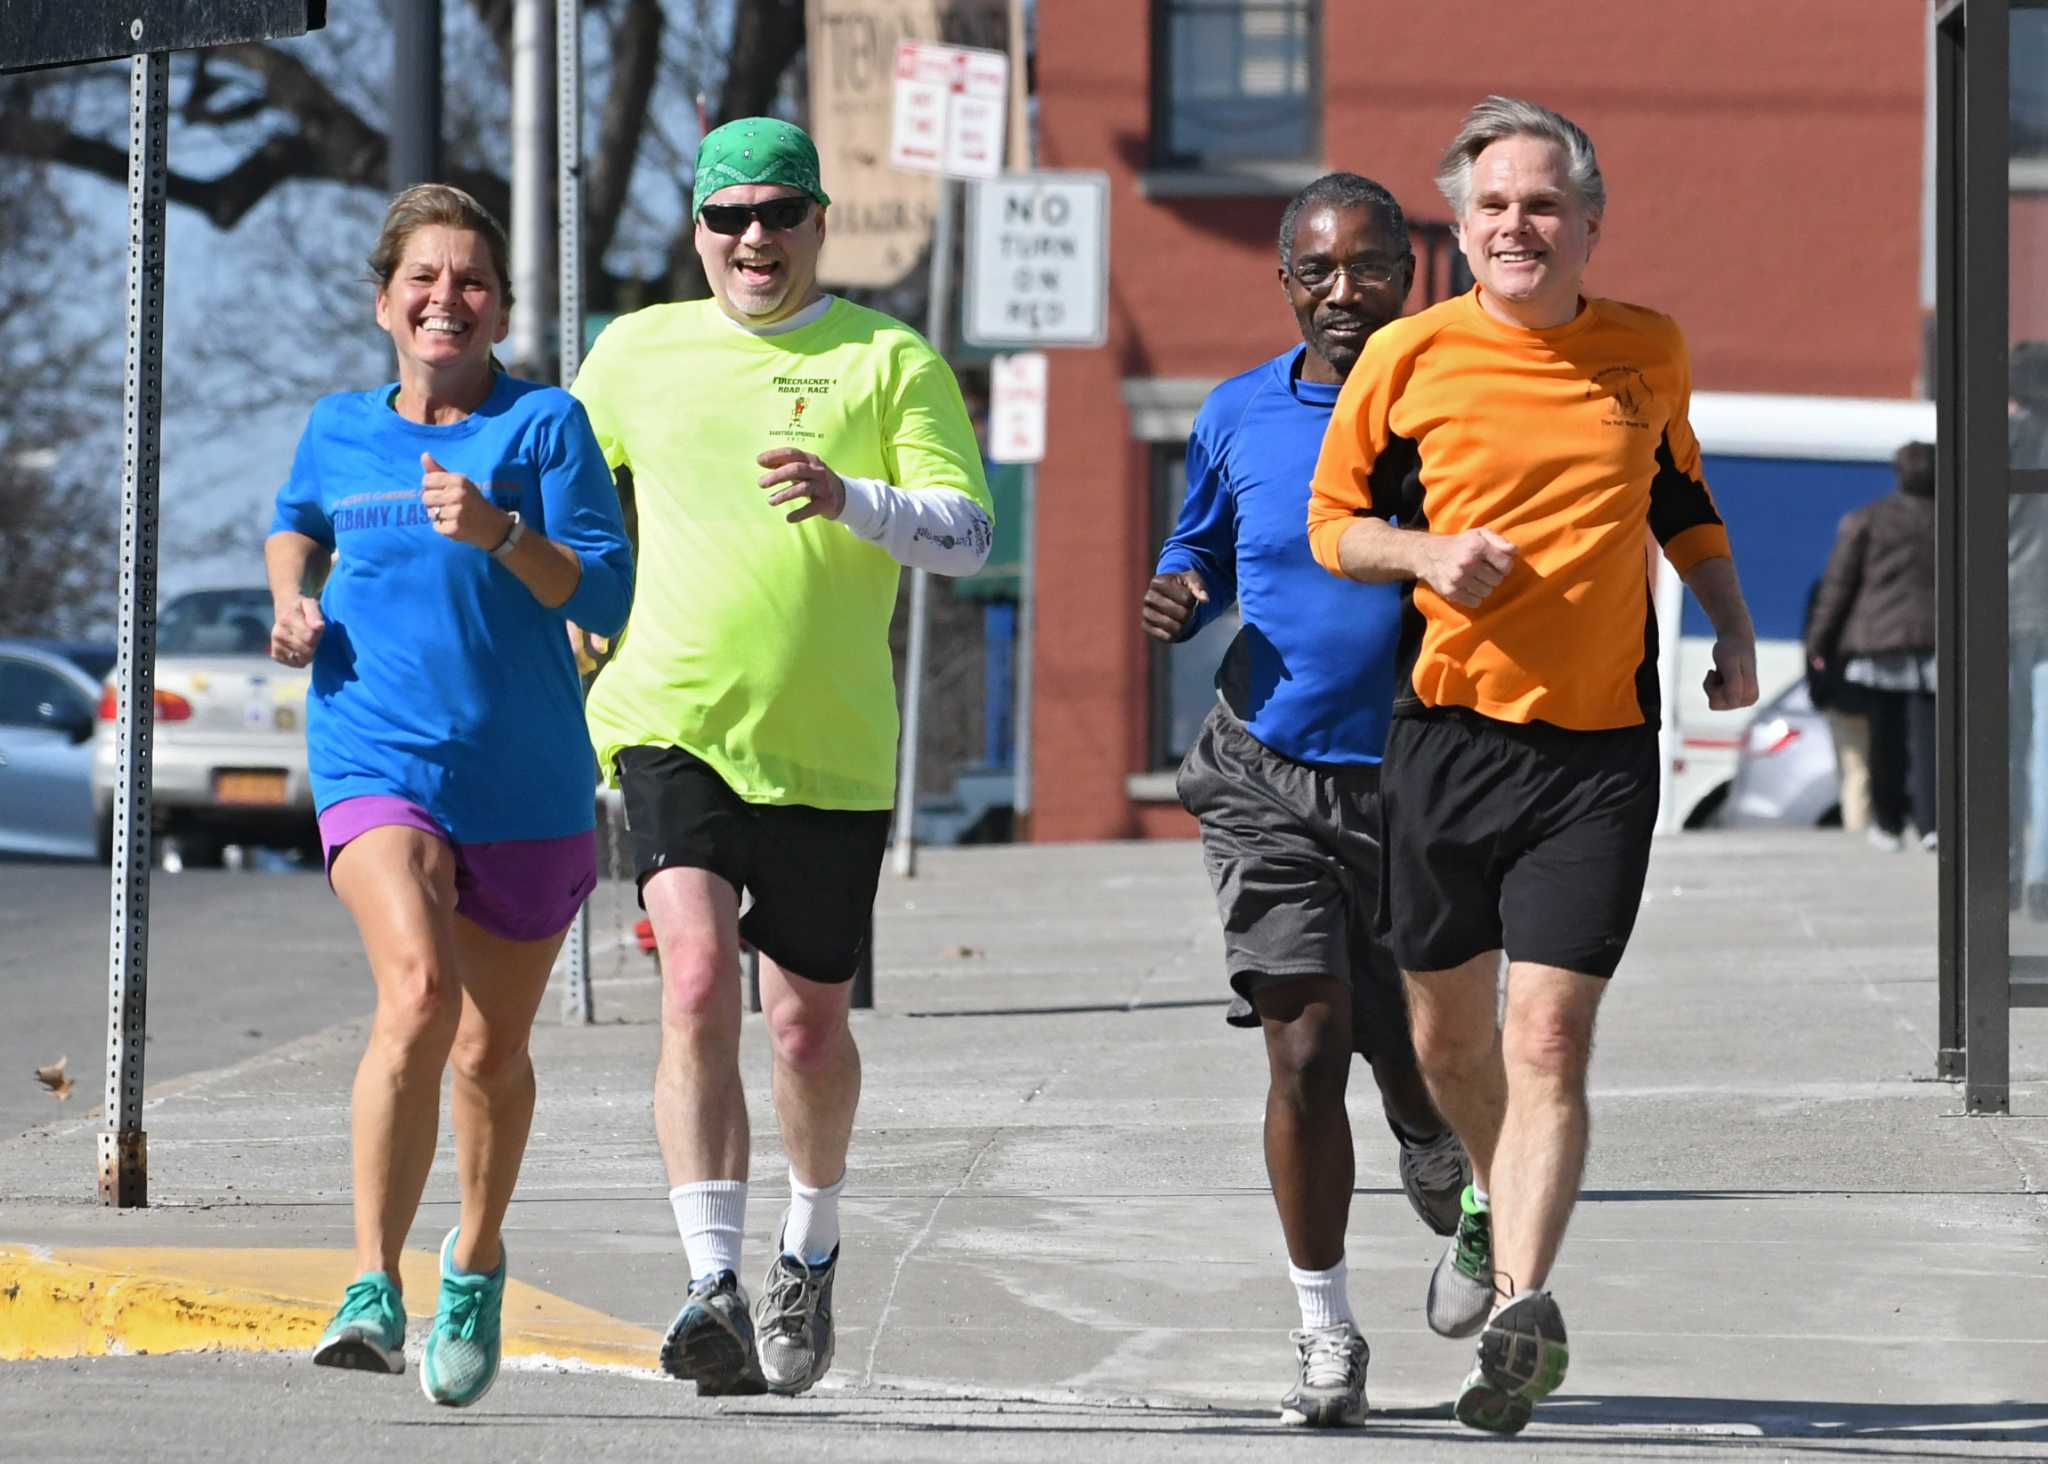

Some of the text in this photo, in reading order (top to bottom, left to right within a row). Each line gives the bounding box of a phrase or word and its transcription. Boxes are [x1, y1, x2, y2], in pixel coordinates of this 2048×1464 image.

[1004, 194, 1070, 227] NO
[1001, 235, 1077, 258] TURN
[807, 386, 829, 394] RACE
